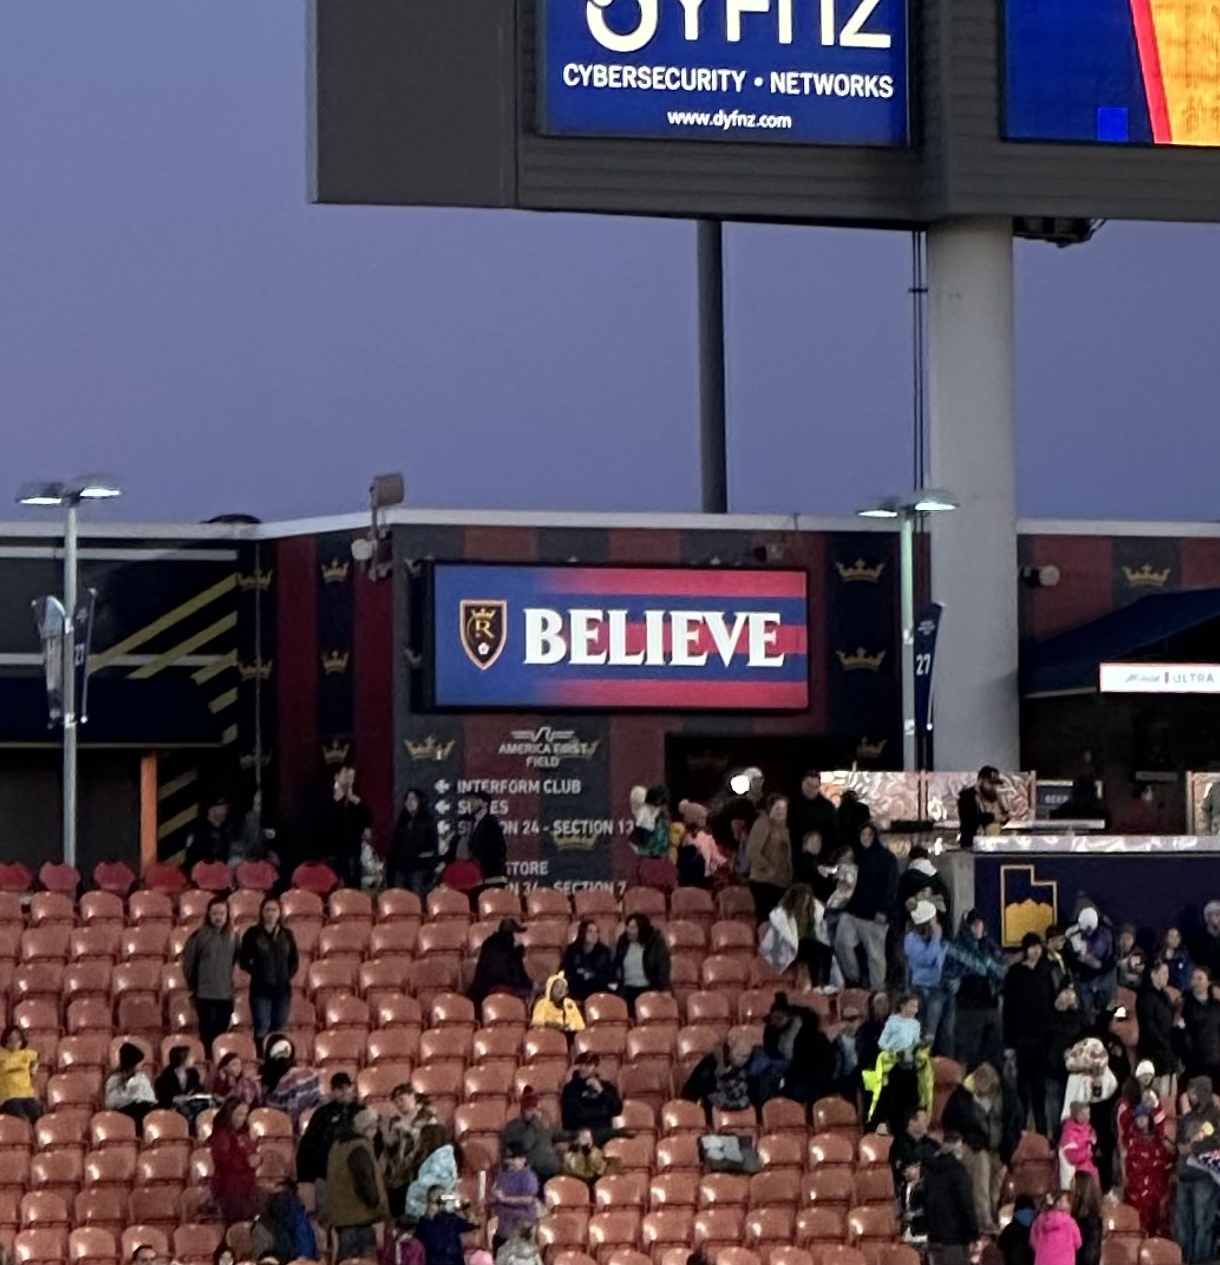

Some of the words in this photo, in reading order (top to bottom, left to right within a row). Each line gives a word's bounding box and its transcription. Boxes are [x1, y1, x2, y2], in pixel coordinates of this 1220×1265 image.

[563, 63, 745, 93] CYBERSECURITY
[770, 70, 893, 98] NETWORKS
[667, 108, 792, 130] www.dyfnz.com
[524, 608, 785, 667] BELIEVE
[915, 653, 931, 676] 27
[1172, 672, 1214, 684] ULTRA
[498, 743, 551, 755] AMERICA
[553, 743, 588, 755] FIRST
[526, 756, 560, 768] FIELD
[457, 779, 540, 794] INTERFORM
[543, 779, 581, 794] CLUB
[522, 820, 540, 834] 24
[553, 820, 613, 834] SECTION
